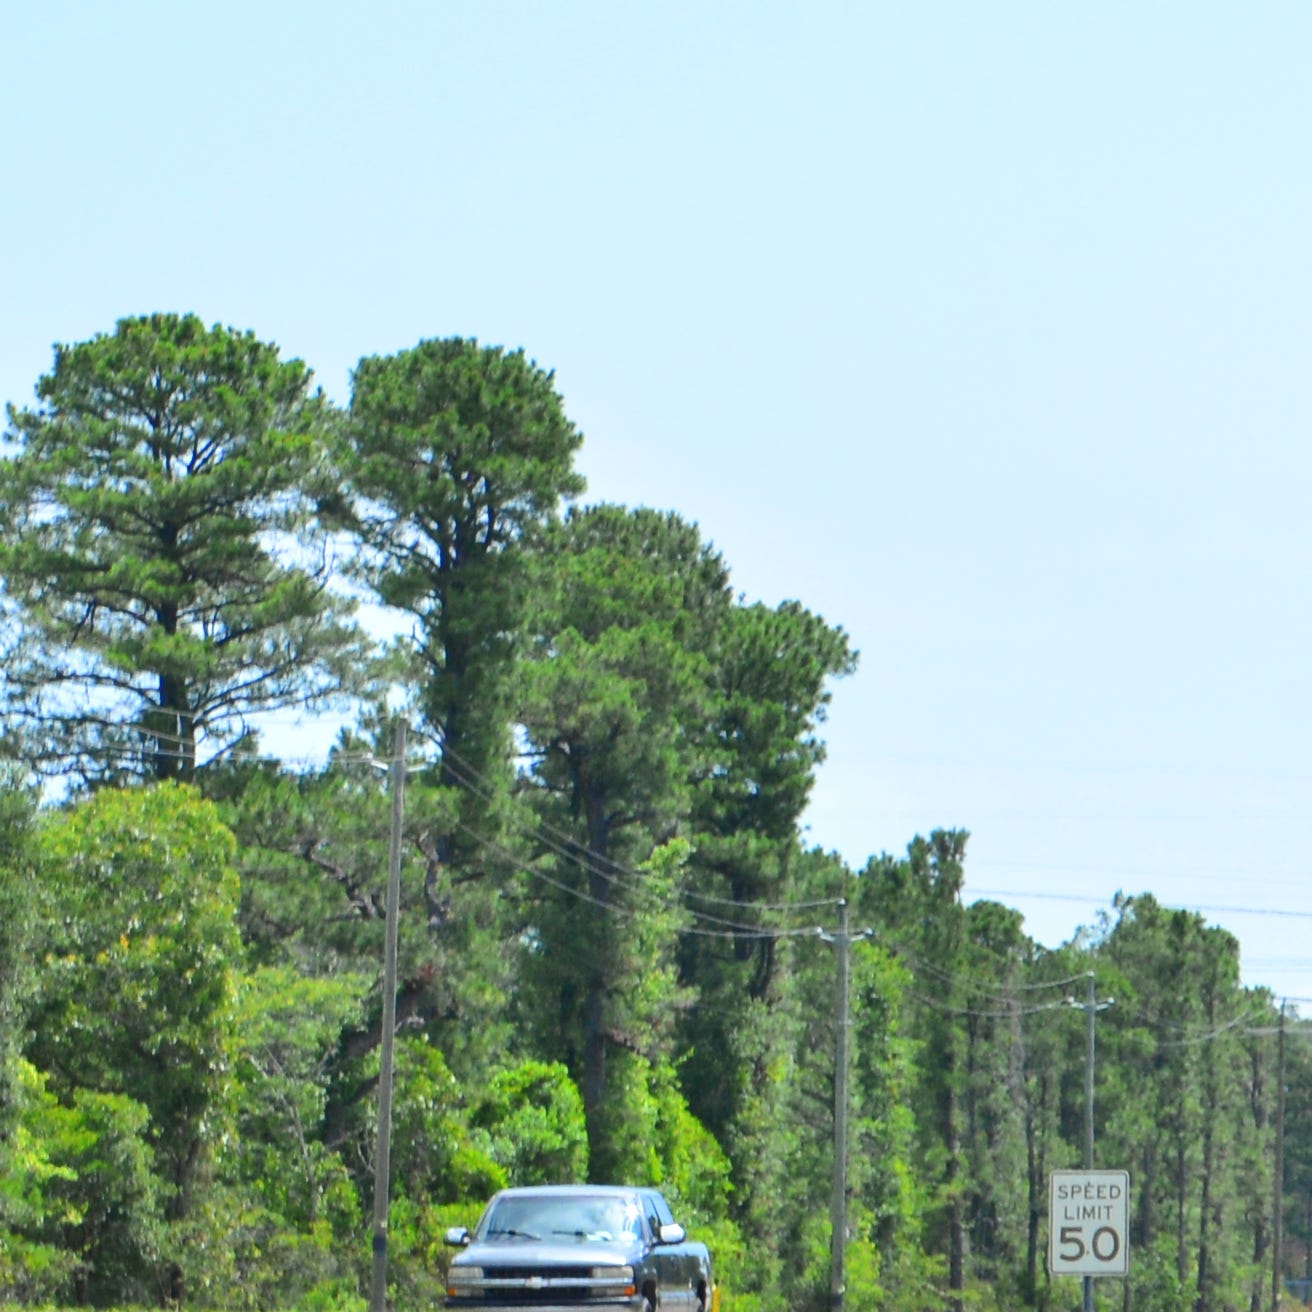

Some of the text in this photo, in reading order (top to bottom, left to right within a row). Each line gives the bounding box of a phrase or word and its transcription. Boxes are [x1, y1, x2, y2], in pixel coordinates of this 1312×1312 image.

[1057, 1184, 1122, 1200] SPEED
[1064, 1205, 1114, 1221] LIMIT
[1059, 1226, 1120, 1262] 50
